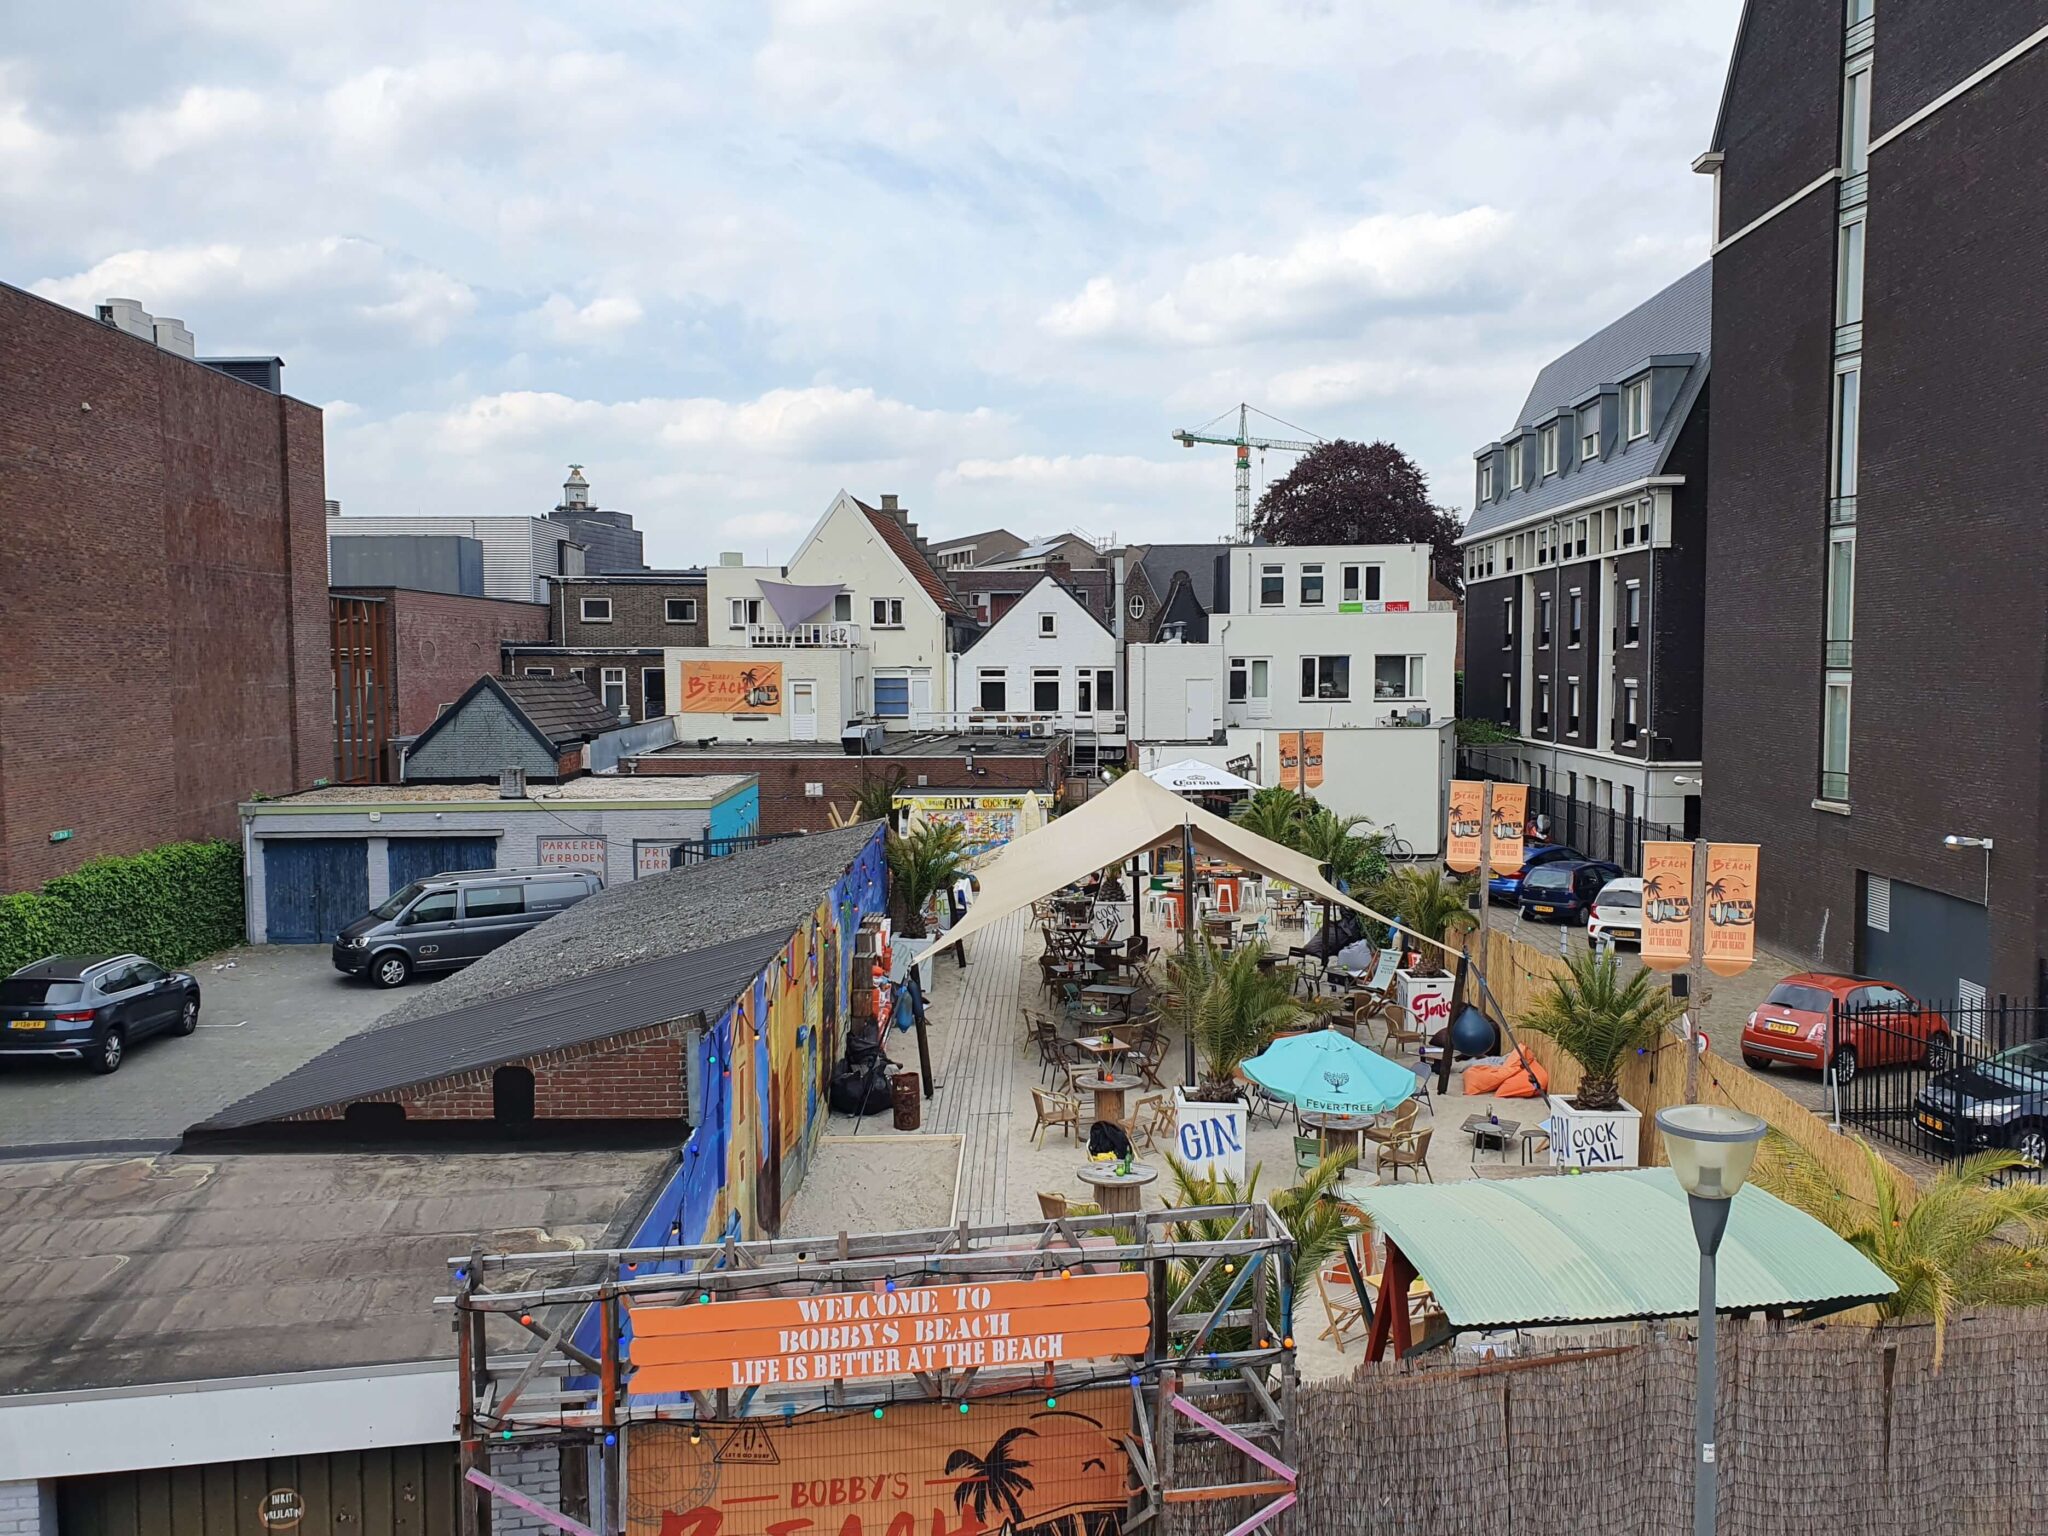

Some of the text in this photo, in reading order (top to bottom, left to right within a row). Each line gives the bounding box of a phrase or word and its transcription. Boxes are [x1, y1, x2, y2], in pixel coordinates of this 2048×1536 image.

[1386, 602, 1409, 613] Sicilia
[686, 675, 748, 699] BEACH
[1172, 779, 1221, 787] Corona
[541, 853, 606, 863] VERBODEN
[542, 841, 605, 851] PARKEREN
[1647, 857, 1687, 871] BEACH
[1711, 859, 1752, 873] BEACH
[1095, 903, 1120, 921] COCK
[1098, 913, 1125, 931] TAIL
[1411, 991, 1453, 1023] Tonic
[1306, 1098, 1374, 1112] FEVER-TREE
[1180, 1113, 1243, 1161] GIN
[1550, 1114, 1570, 1159] GIN
[1572, 1120, 1618, 1148] COCK
[1575, 1142, 1624, 1167] TAIL
[797, 1287, 992, 1322] WELCOME TO
[914, 1312, 1011, 1343] BEACH
[731, 1333, 1064, 1385] LIFE IS BETTER AT THE BEACH
[791, 1472, 909, 1509] BOBBY'S
